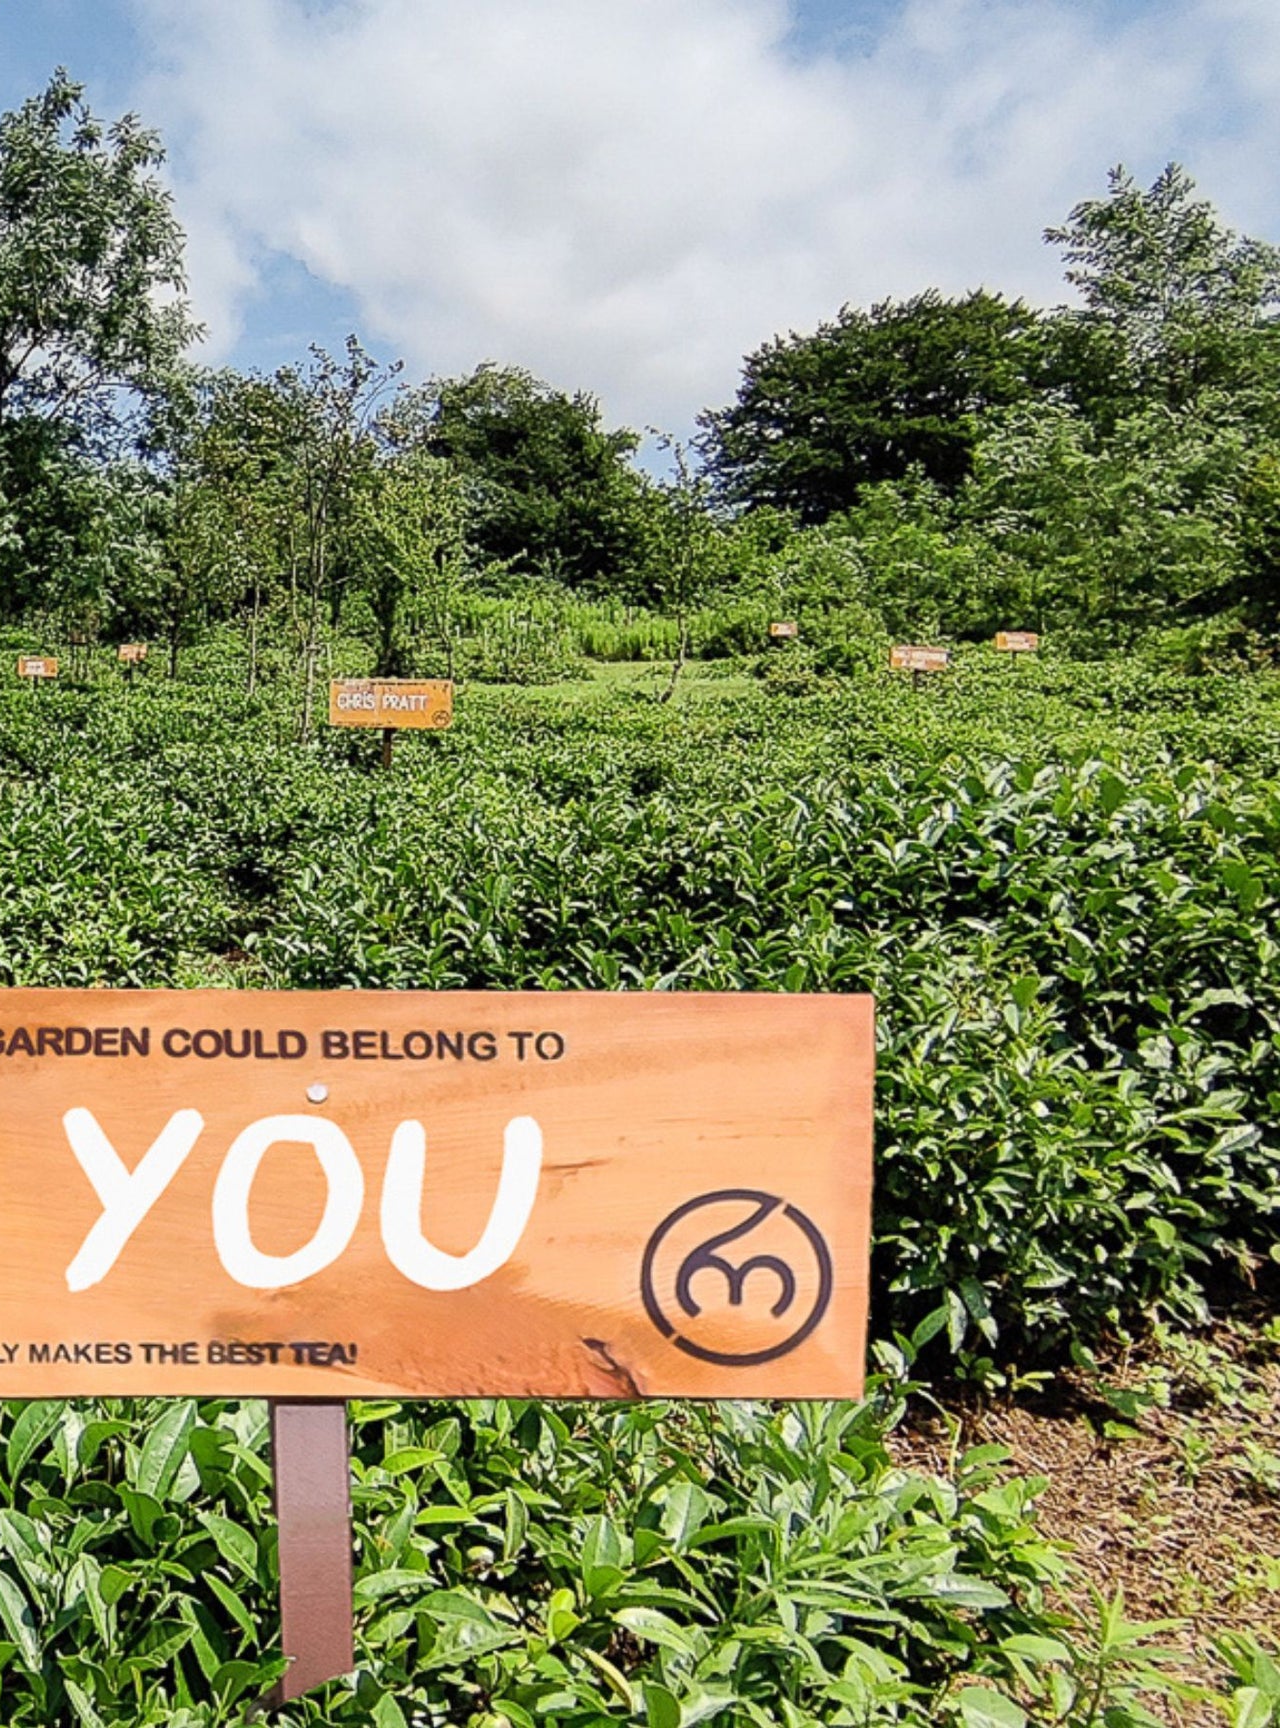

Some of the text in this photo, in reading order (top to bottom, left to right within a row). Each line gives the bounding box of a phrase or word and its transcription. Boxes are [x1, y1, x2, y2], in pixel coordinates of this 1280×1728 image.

[381, 693, 428, 711] PRATT
[162, 1028, 307, 1059] COULD
[321, 1030, 498, 1061] BELONG
[508, 1031, 565, 1061] TO
[62, 1107, 543, 1293] YOU
[28, 1343, 132, 1364] MAKES
[139, 1343, 199, 1364] THE
[207, 1341, 285, 1365] BEST
[289, 1342, 358, 1365] TEA!
